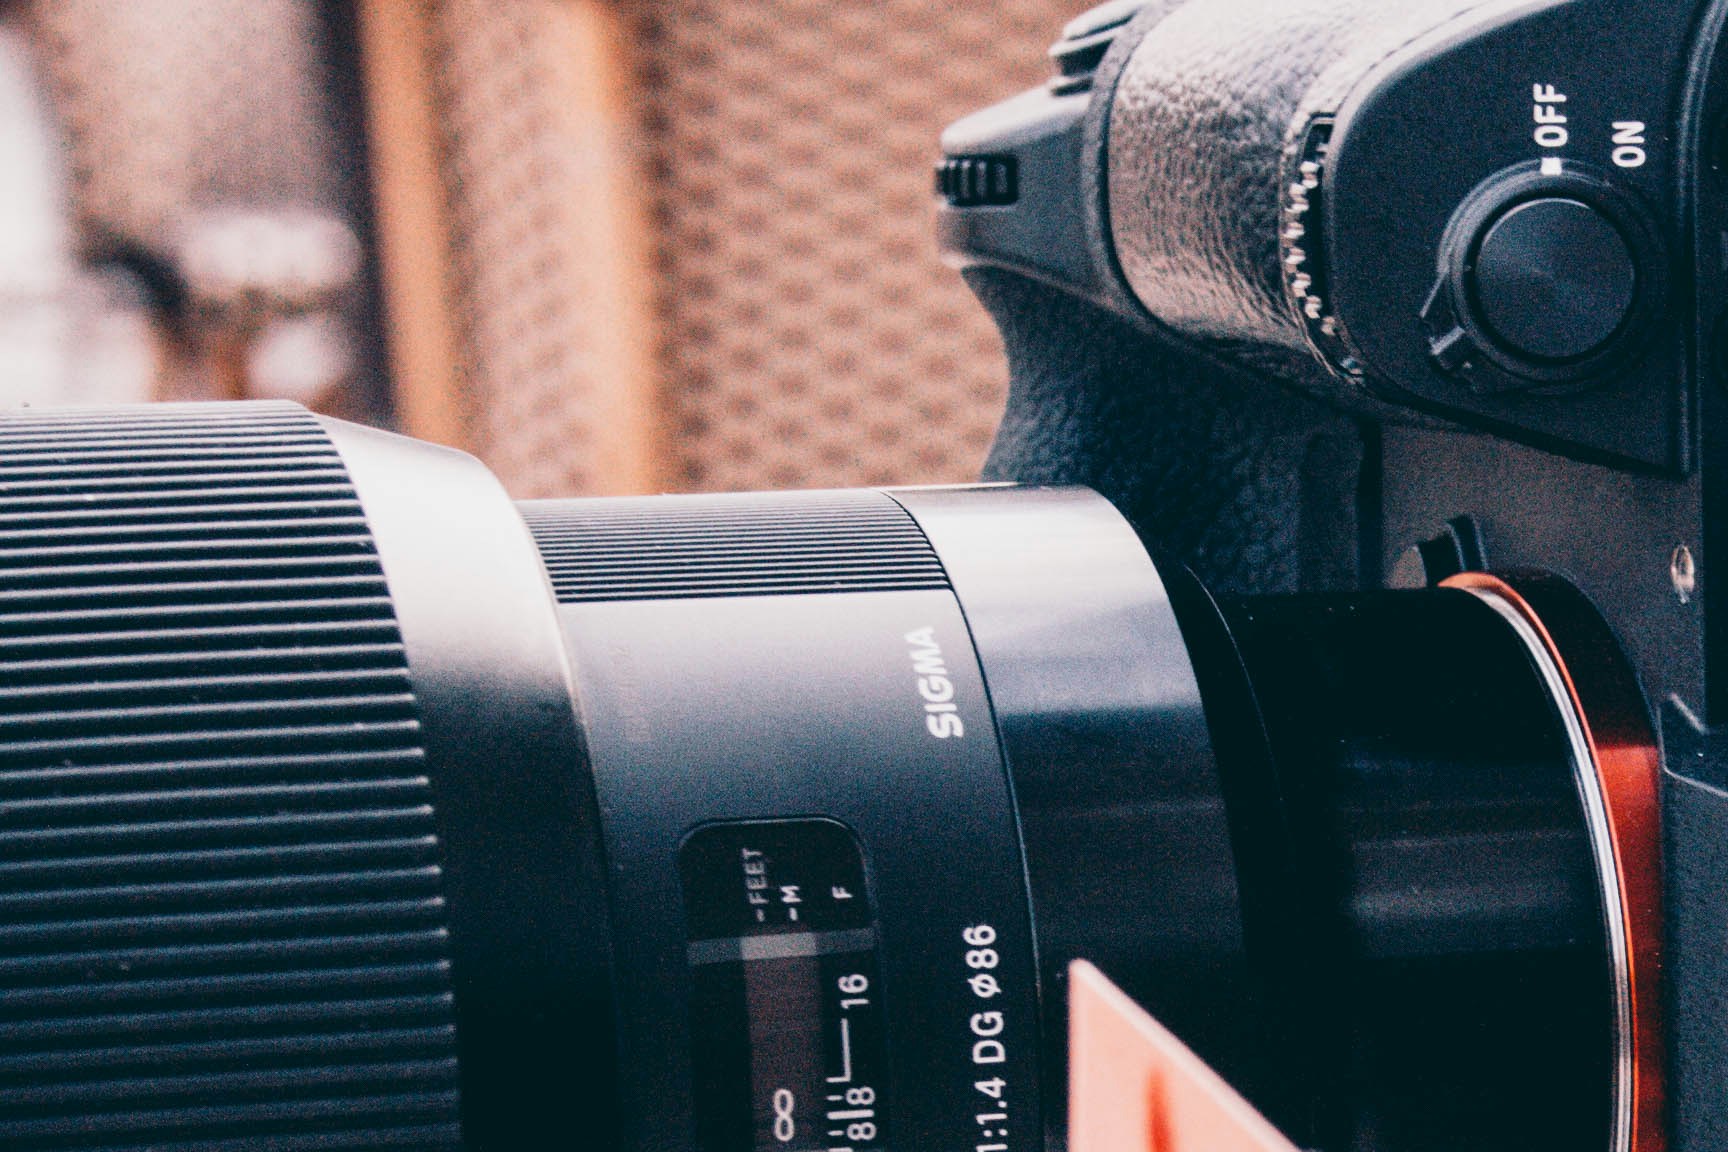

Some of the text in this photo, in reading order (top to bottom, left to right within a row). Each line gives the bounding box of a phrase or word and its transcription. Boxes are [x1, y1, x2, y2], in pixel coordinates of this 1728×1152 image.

[1533, 83, 1567, 147] OFF
[1611, 120, 1646, 168] ON
[905, 626, 963, 738] SIGMA
[832, 885, 853, 900] F
[838, 973, 869, 1008] 16
[971, 1010, 1006, 1065] DG
[846, 1086, 876, 1105] 8
[847, 1122, 877, 1141] 8
